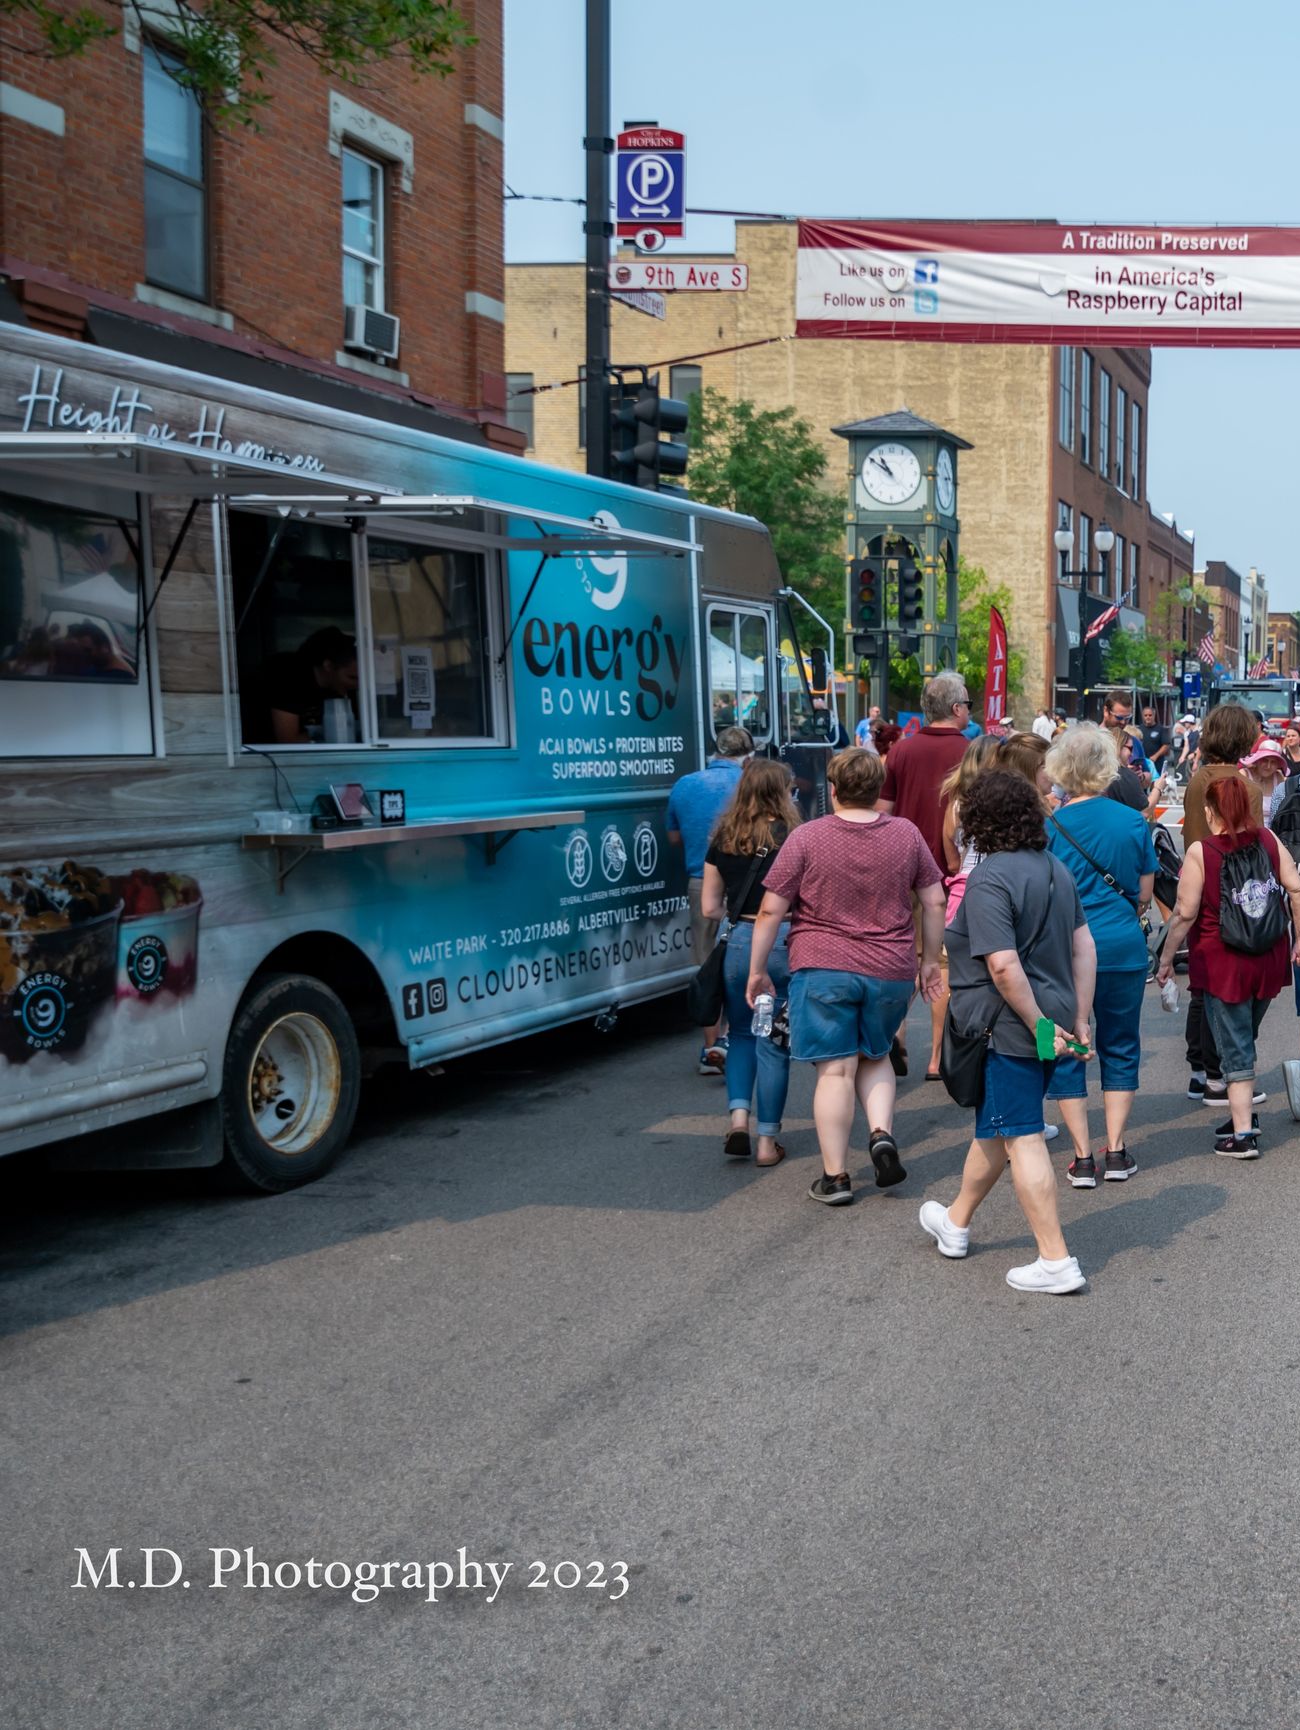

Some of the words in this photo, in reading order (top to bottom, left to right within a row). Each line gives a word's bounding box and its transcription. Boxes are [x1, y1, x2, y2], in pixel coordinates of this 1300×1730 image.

[627, 137, 675, 147] HOPKINS
[641, 160, 664, 199] P
[1062, 232, 1075, 249] A
[1080, 232, 1156, 250] Tradition
[1160, 233, 1249, 252] Preserved
[644, 266, 675, 287] 9th
[687, 266, 719, 287] Ave
[731, 266, 743, 287] S
[839, 262, 867, 280] Like
[869, 267, 885, 279] us
[888, 266, 906, 279] on
[1095, 267, 1111, 287] in
[1118, 265, 1215, 288] America's
[822, 292, 865, 309] Follow
[869, 296, 885, 308] us
[889, 295, 906, 308] on
[1066, 289, 1167, 316] Raspberry
[1175, 288, 1243, 315] Capital
[18, 364, 153, 434] Height
[523, 614, 687, 722] energy
[986, 632, 1004, 721] ATM
[541, 687, 631, 717] BOWLS
[539, 738, 565, 756] ACAI
[567, 737, 607, 755] BOWLS
[616, 737, 656, 754] PROTEIN
[658, 736, 684, 753] BITES
[552, 760, 618, 779] SUPERFOOD
[619, 758, 675, 777] SMOOTHIES
[131, 937, 162, 956] ENERGY
[409, 941, 452, 966] WAITE
[456, 934, 487, 956] PARK
[500, 920, 570, 947] 320.217.8886
[577, 904, 640, 932] ALBERTVILLE
[19, 973, 68, 996] ENERGY
